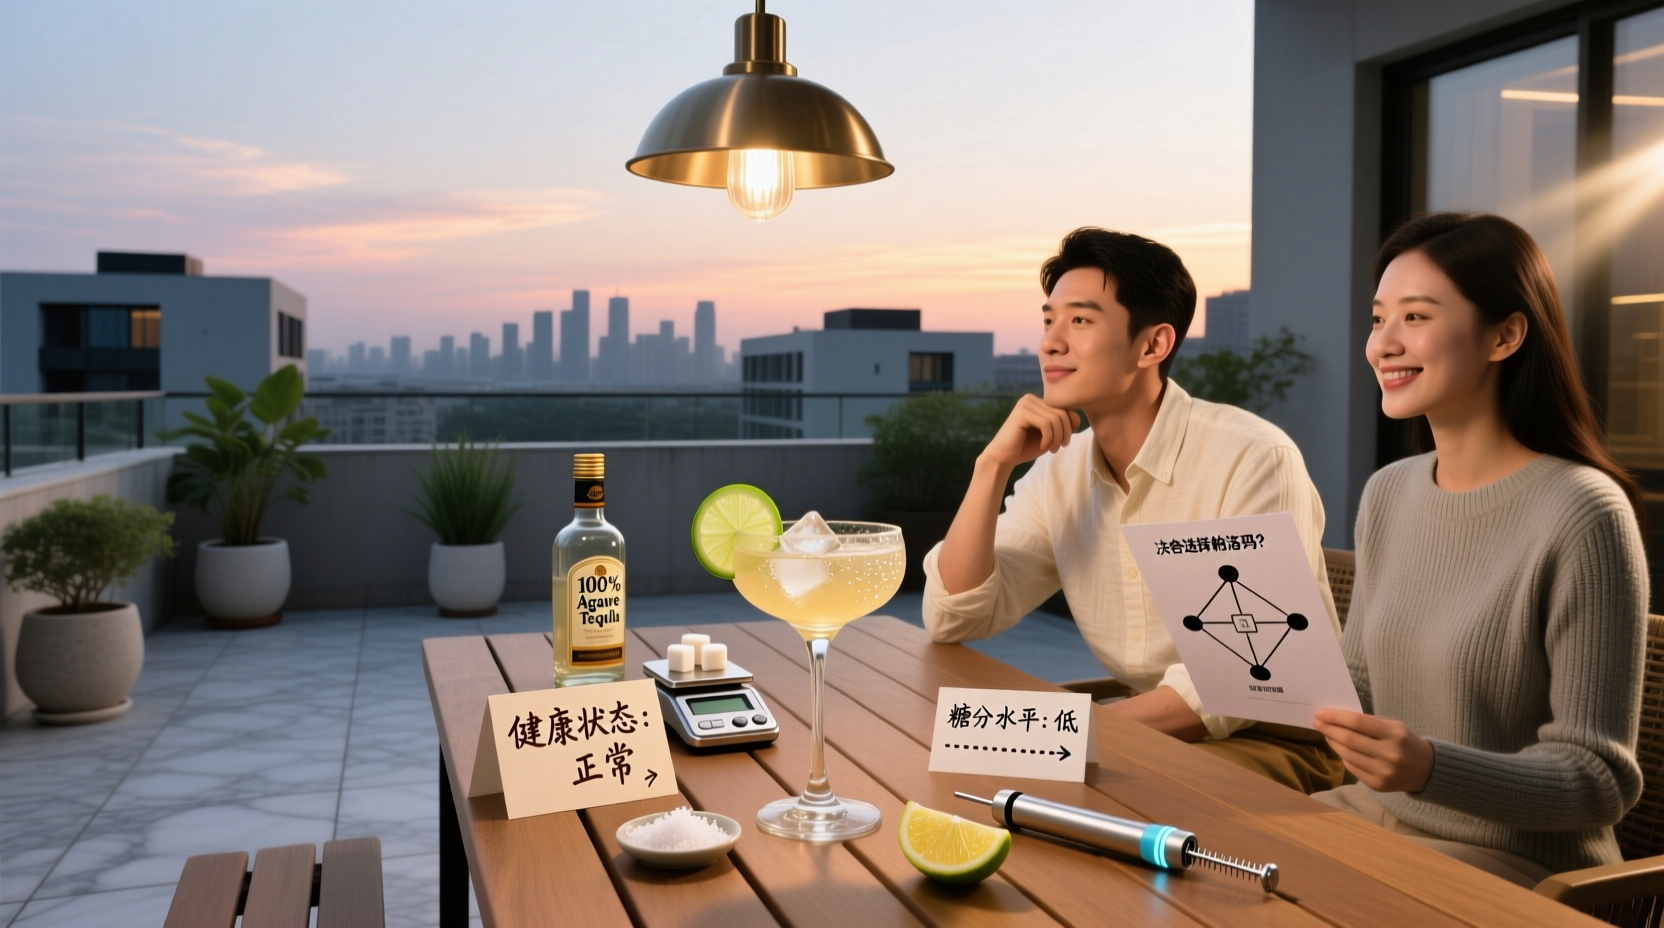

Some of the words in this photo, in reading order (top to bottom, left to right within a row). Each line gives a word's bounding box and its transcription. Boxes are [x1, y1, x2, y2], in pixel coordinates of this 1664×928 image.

[577, 575, 621, 594] 100%
[507, 700, 649, 749] 健康状态:
[572, 742, 634, 786] 正常
